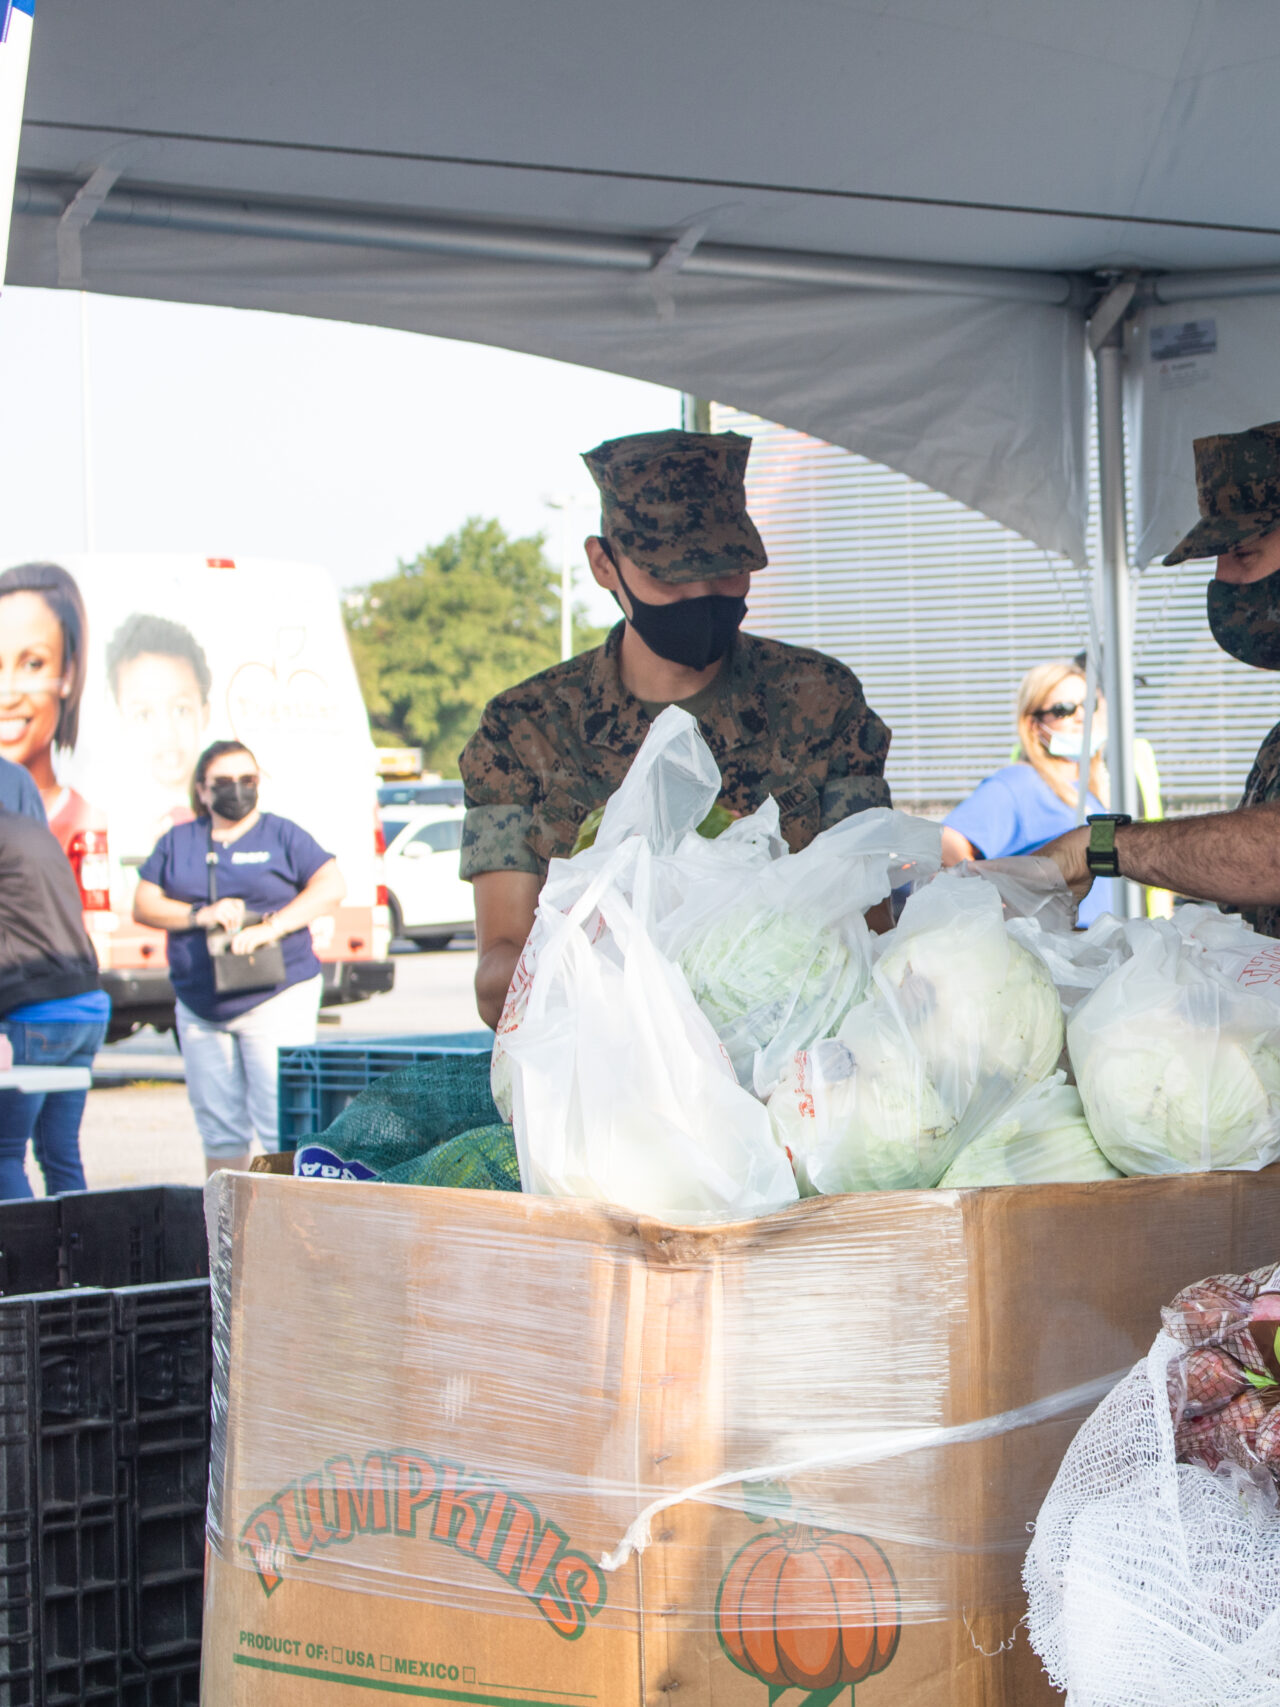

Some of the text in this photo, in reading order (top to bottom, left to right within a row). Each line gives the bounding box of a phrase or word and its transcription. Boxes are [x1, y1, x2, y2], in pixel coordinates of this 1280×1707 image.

[239, 1447, 606, 1641] PUMPKINS
[239, 1630, 460, 1681] PRODUCT OF: USA MEXICO
